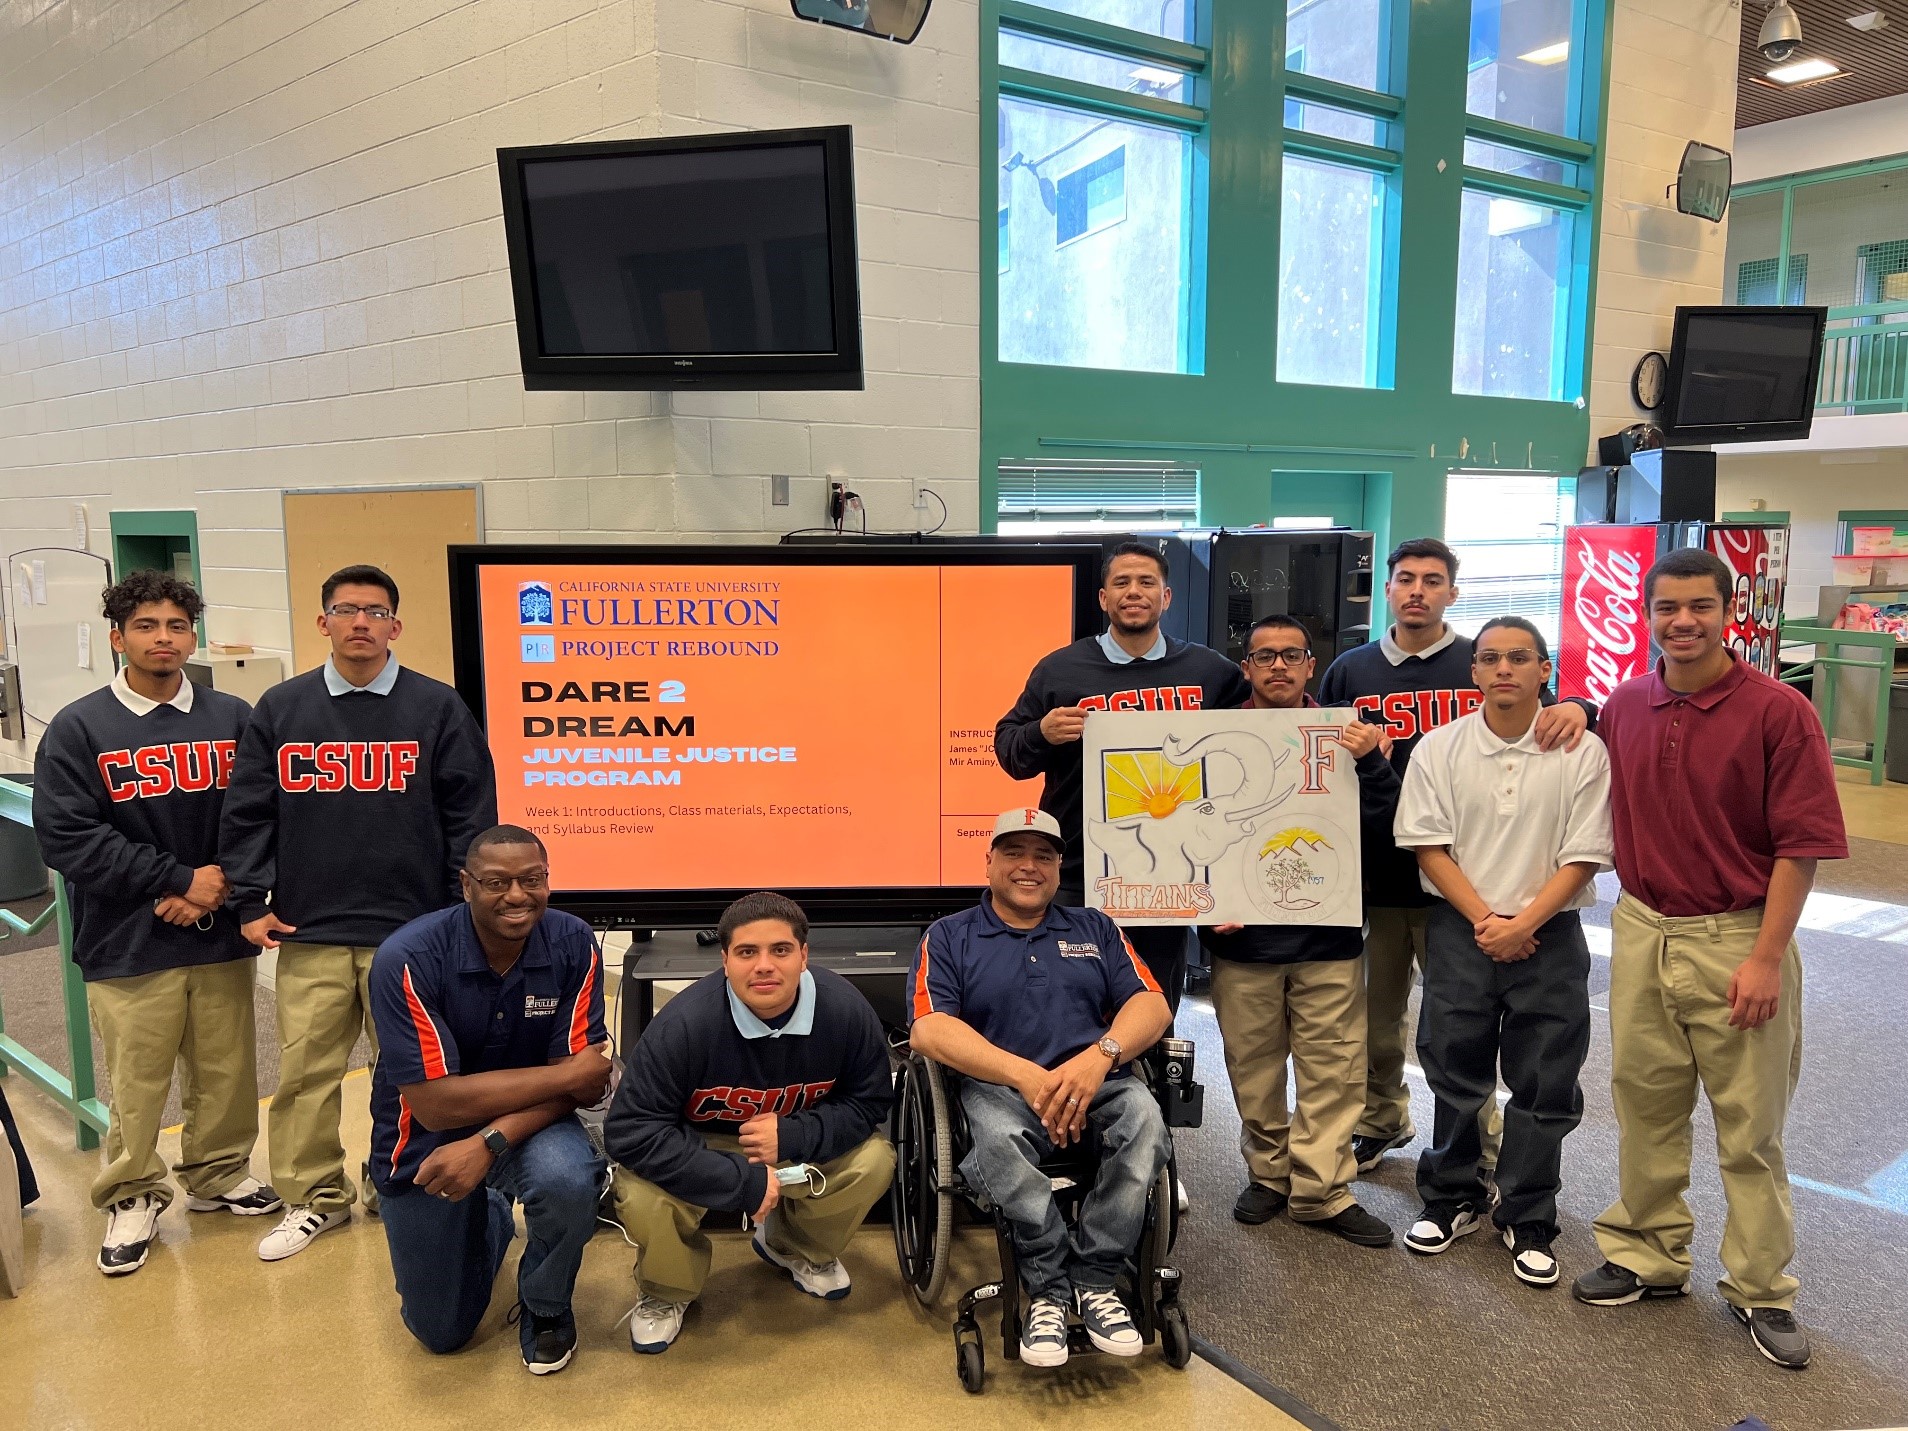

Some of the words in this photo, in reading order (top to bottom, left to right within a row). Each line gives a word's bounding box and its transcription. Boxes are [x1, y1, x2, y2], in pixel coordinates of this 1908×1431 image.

[559, 581, 645, 593] CALIFORNIA
[649, 581, 692, 593] STATE
[696, 581, 781, 593] UNIVERSITY
[559, 598, 780, 626] FULLERTON
[1575, 537, 1641, 721] ca-Cola
[561, 641, 660, 661] PROJECT
[667, 641, 779, 657] REBOUND
[521, 681, 651, 703] DARE
[658, 680, 686, 703] 2
[523, 716, 695, 738] DREAM
[522, 748, 671, 764] JUVENILE
[675, 747, 797, 763] JUSTICE
[949, 745, 978, 753] James
[277, 741, 419, 793] CSUF
[949, 758, 965, 766] Mir
[966, 758, 999, 767] Aminy,
[1298, 726, 1343, 794] F
[97, 740, 237, 802] CSUF
[523, 770, 681, 787] PROGRAM
[525, 806, 560, 817] Week
[562, 806, 573, 817] 1:
[576, 805, 665, 818] Introductions,
[668, 805, 702, 816] Class
[705, 804, 766, 817] materials,
[769, 804, 852, 818] Expectations,
[1023, 808, 1039, 826] F
[526, 823, 550, 834] and
[553, 823, 606, 836] Syllabus
[610, 823, 654, 834] Review
[956, 828, 994, 839] Septem
